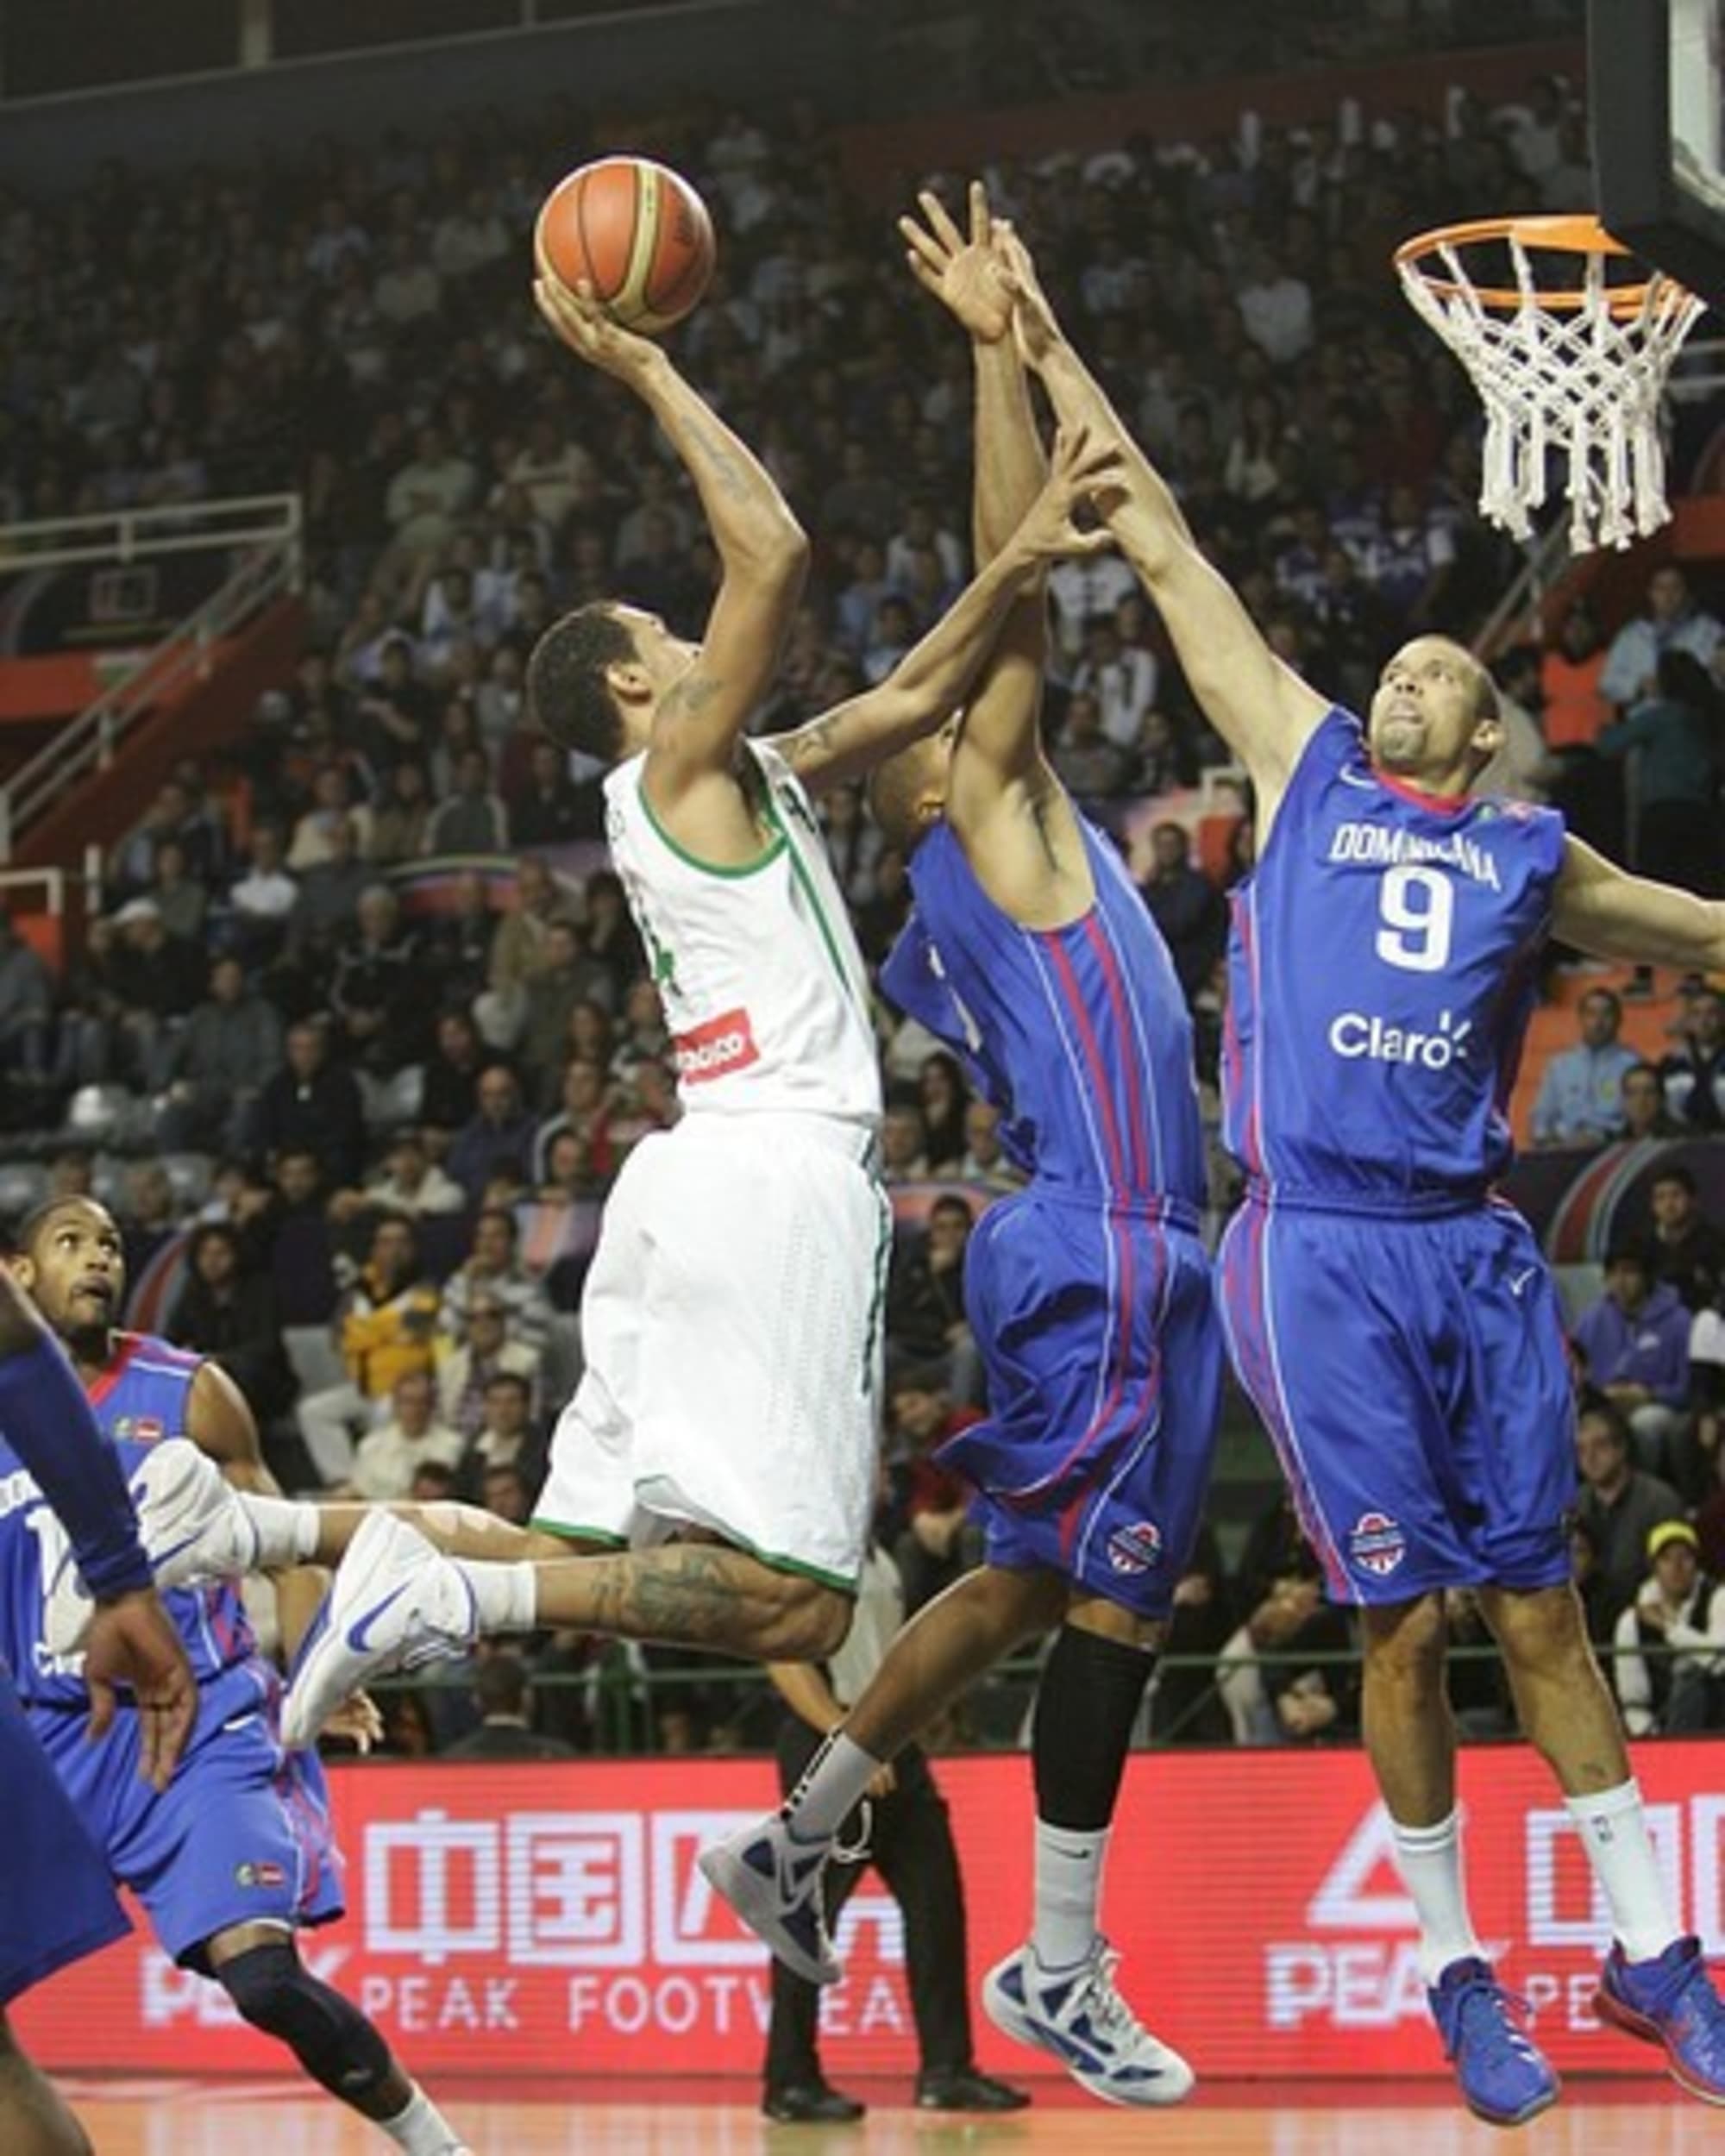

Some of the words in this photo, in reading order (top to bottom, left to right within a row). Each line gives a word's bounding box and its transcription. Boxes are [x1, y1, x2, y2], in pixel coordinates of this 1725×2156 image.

[1375, 865, 1454, 972] 9
[1329, 1012, 1452, 1069] Claro
[361, 1979, 518, 2028] PEAK
